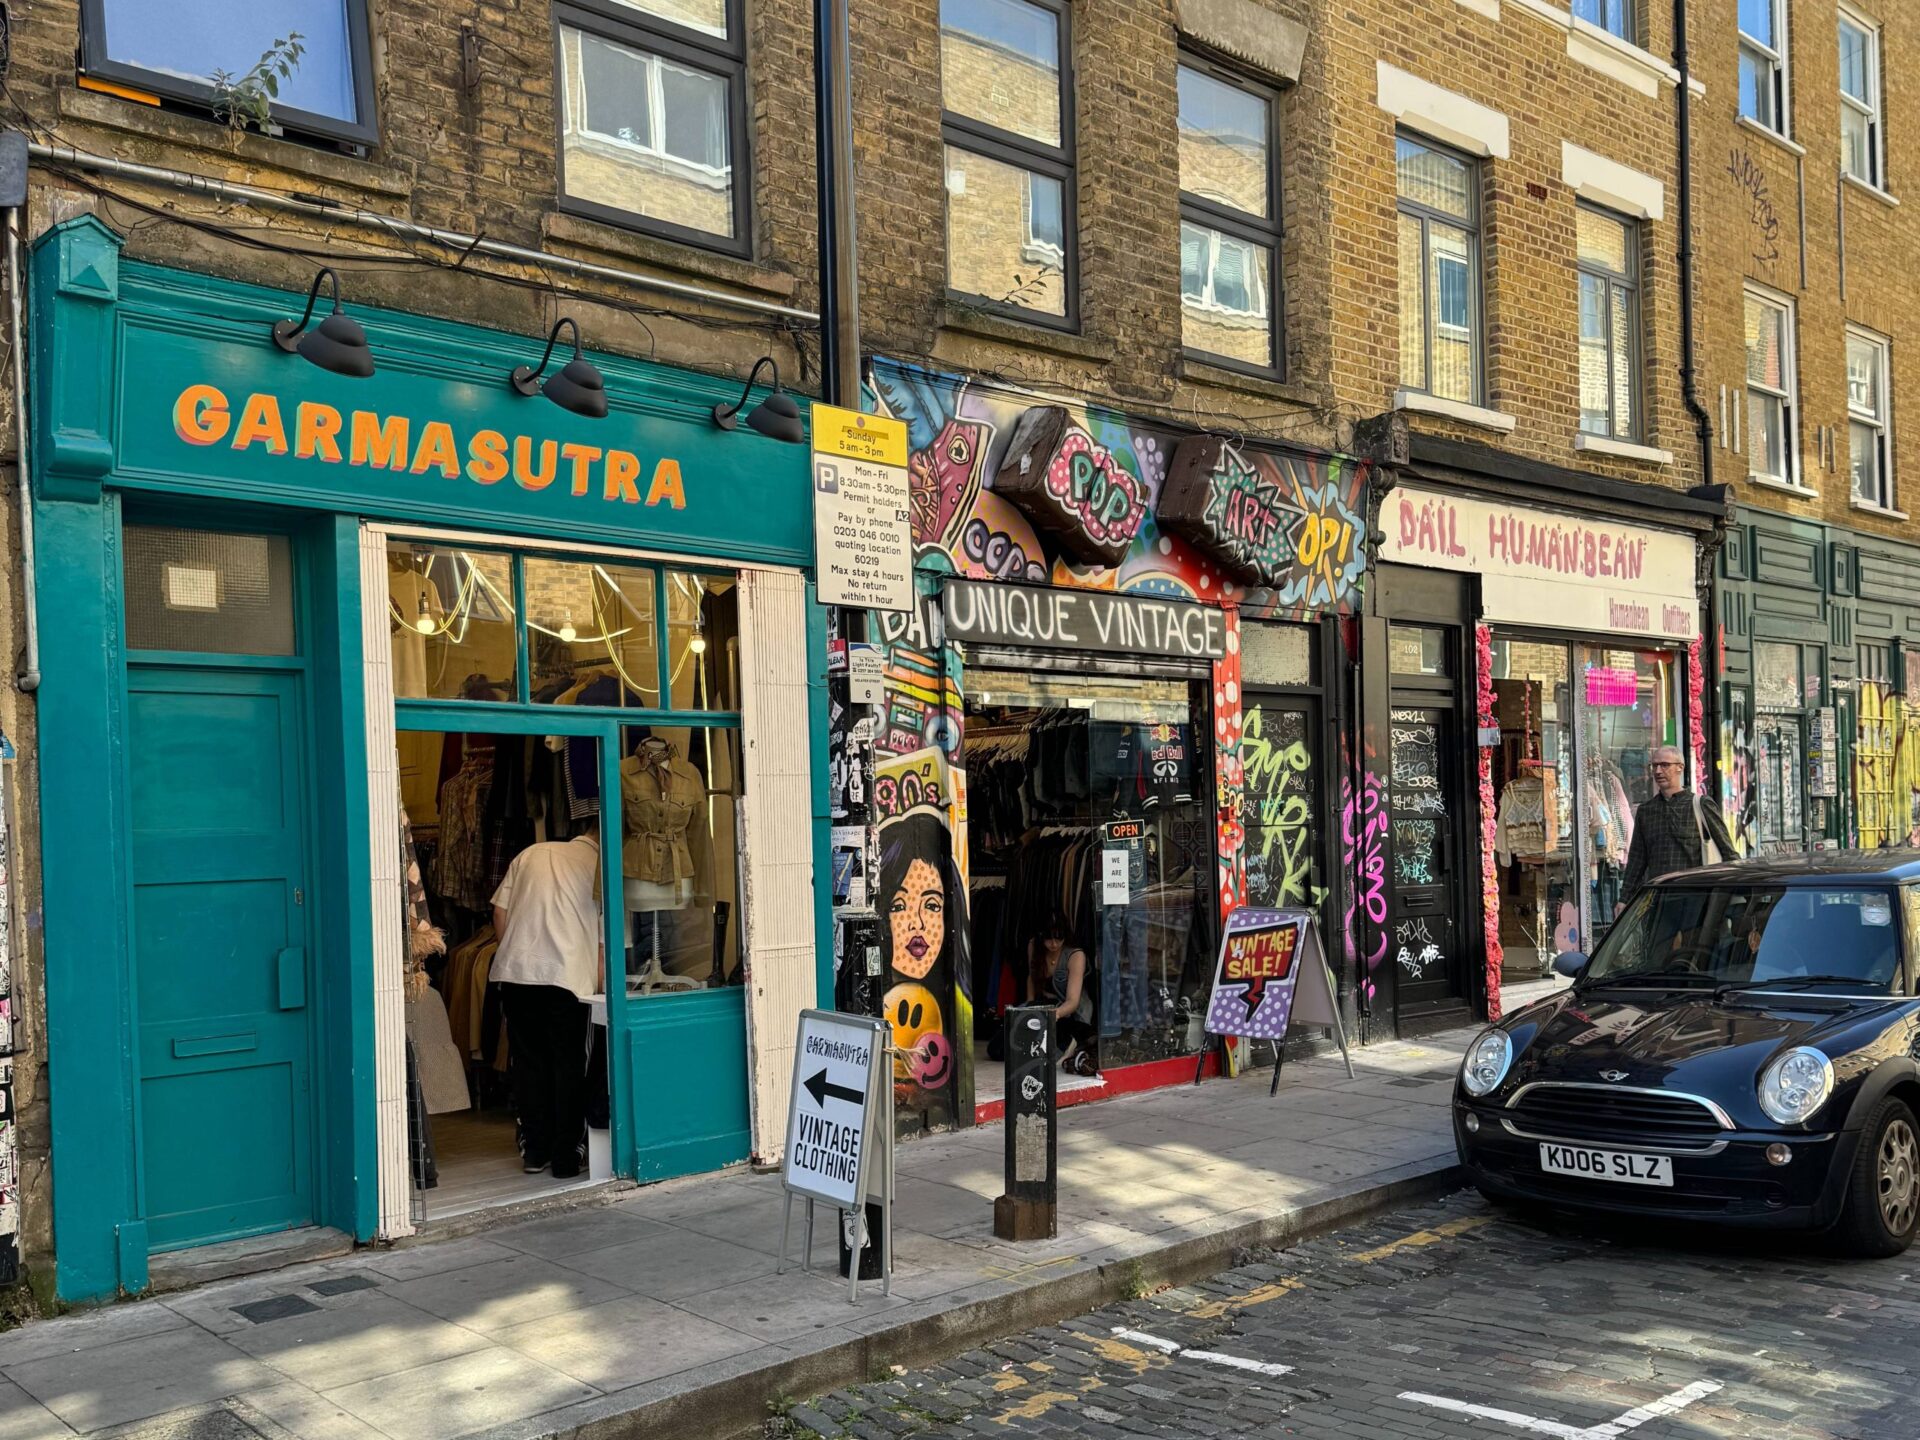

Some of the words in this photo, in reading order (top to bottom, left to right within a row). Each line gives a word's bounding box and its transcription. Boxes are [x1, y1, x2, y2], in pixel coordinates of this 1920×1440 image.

[847, 429, 876, 445] Sunday
[173, 383, 686, 509] GARMASUTRA
[855, 465, 872, 477] Mon
[878, 470, 889, 480] Fri
[1071, 451, 1132, 528] POP
[843, 491, 870, 504] Permit
[873, 495, 902, 509] holders
[867, 506, 876, 514] or
[896, 511, 910, 522] A2
[1224, 487, 1280, 547] ART
[838, 512, 853, 524] Pay
[856, 514, 866, 526] by
[869, 517, 893, 529] phone
[1399, 498, 1467, 558] DAIL
[833, 525, 857, 538] 0203
[859, 529, 877, 540] 046
[880, 532, 900, 543] 0010
[835, 540, 866, 553] quoting
[869, 543, 902, 556] location
[1298, 511, 1352, 578] OP!
[854, 554, 880, 566] 60219
[831, 564, 849, 576] Max
[852, 567, 870, 579] stay
[873, 569, 879, 579] 4
[882, 571, 904, 582] hours
[848, 578, 860, 588] No
[862, 580, 887, 591] return
[840, 591, 866, 602] within
[875, 594, 893, 605] hour
[950, 585, 1078, 642] UNIQUE
[1089, 599, 1223, 655] VINTAGE
[1404, 644, 1418, 654] 102
[865, 689, 872, 699] 6
[1166, 744, 1184, 760] Bull
[1112, 823, 1139, 838] OPEN
[1111, 856, 1121, 864] WE
[1111, 868, 1122, 877] ARE
[1106, 881, 1126, 889] HIRING
[1228, 927, 1296, 957] VINTAGE
[1227, 954, 1282, 979] SALE!
[799, 1112, 860, 1158] VINTAGE
[794, 1141, 857, 1184] CLOTHING
[1546, 1145, 1606, 1174] KD06
[1612, 1154, 1661, 1180] SLZ
